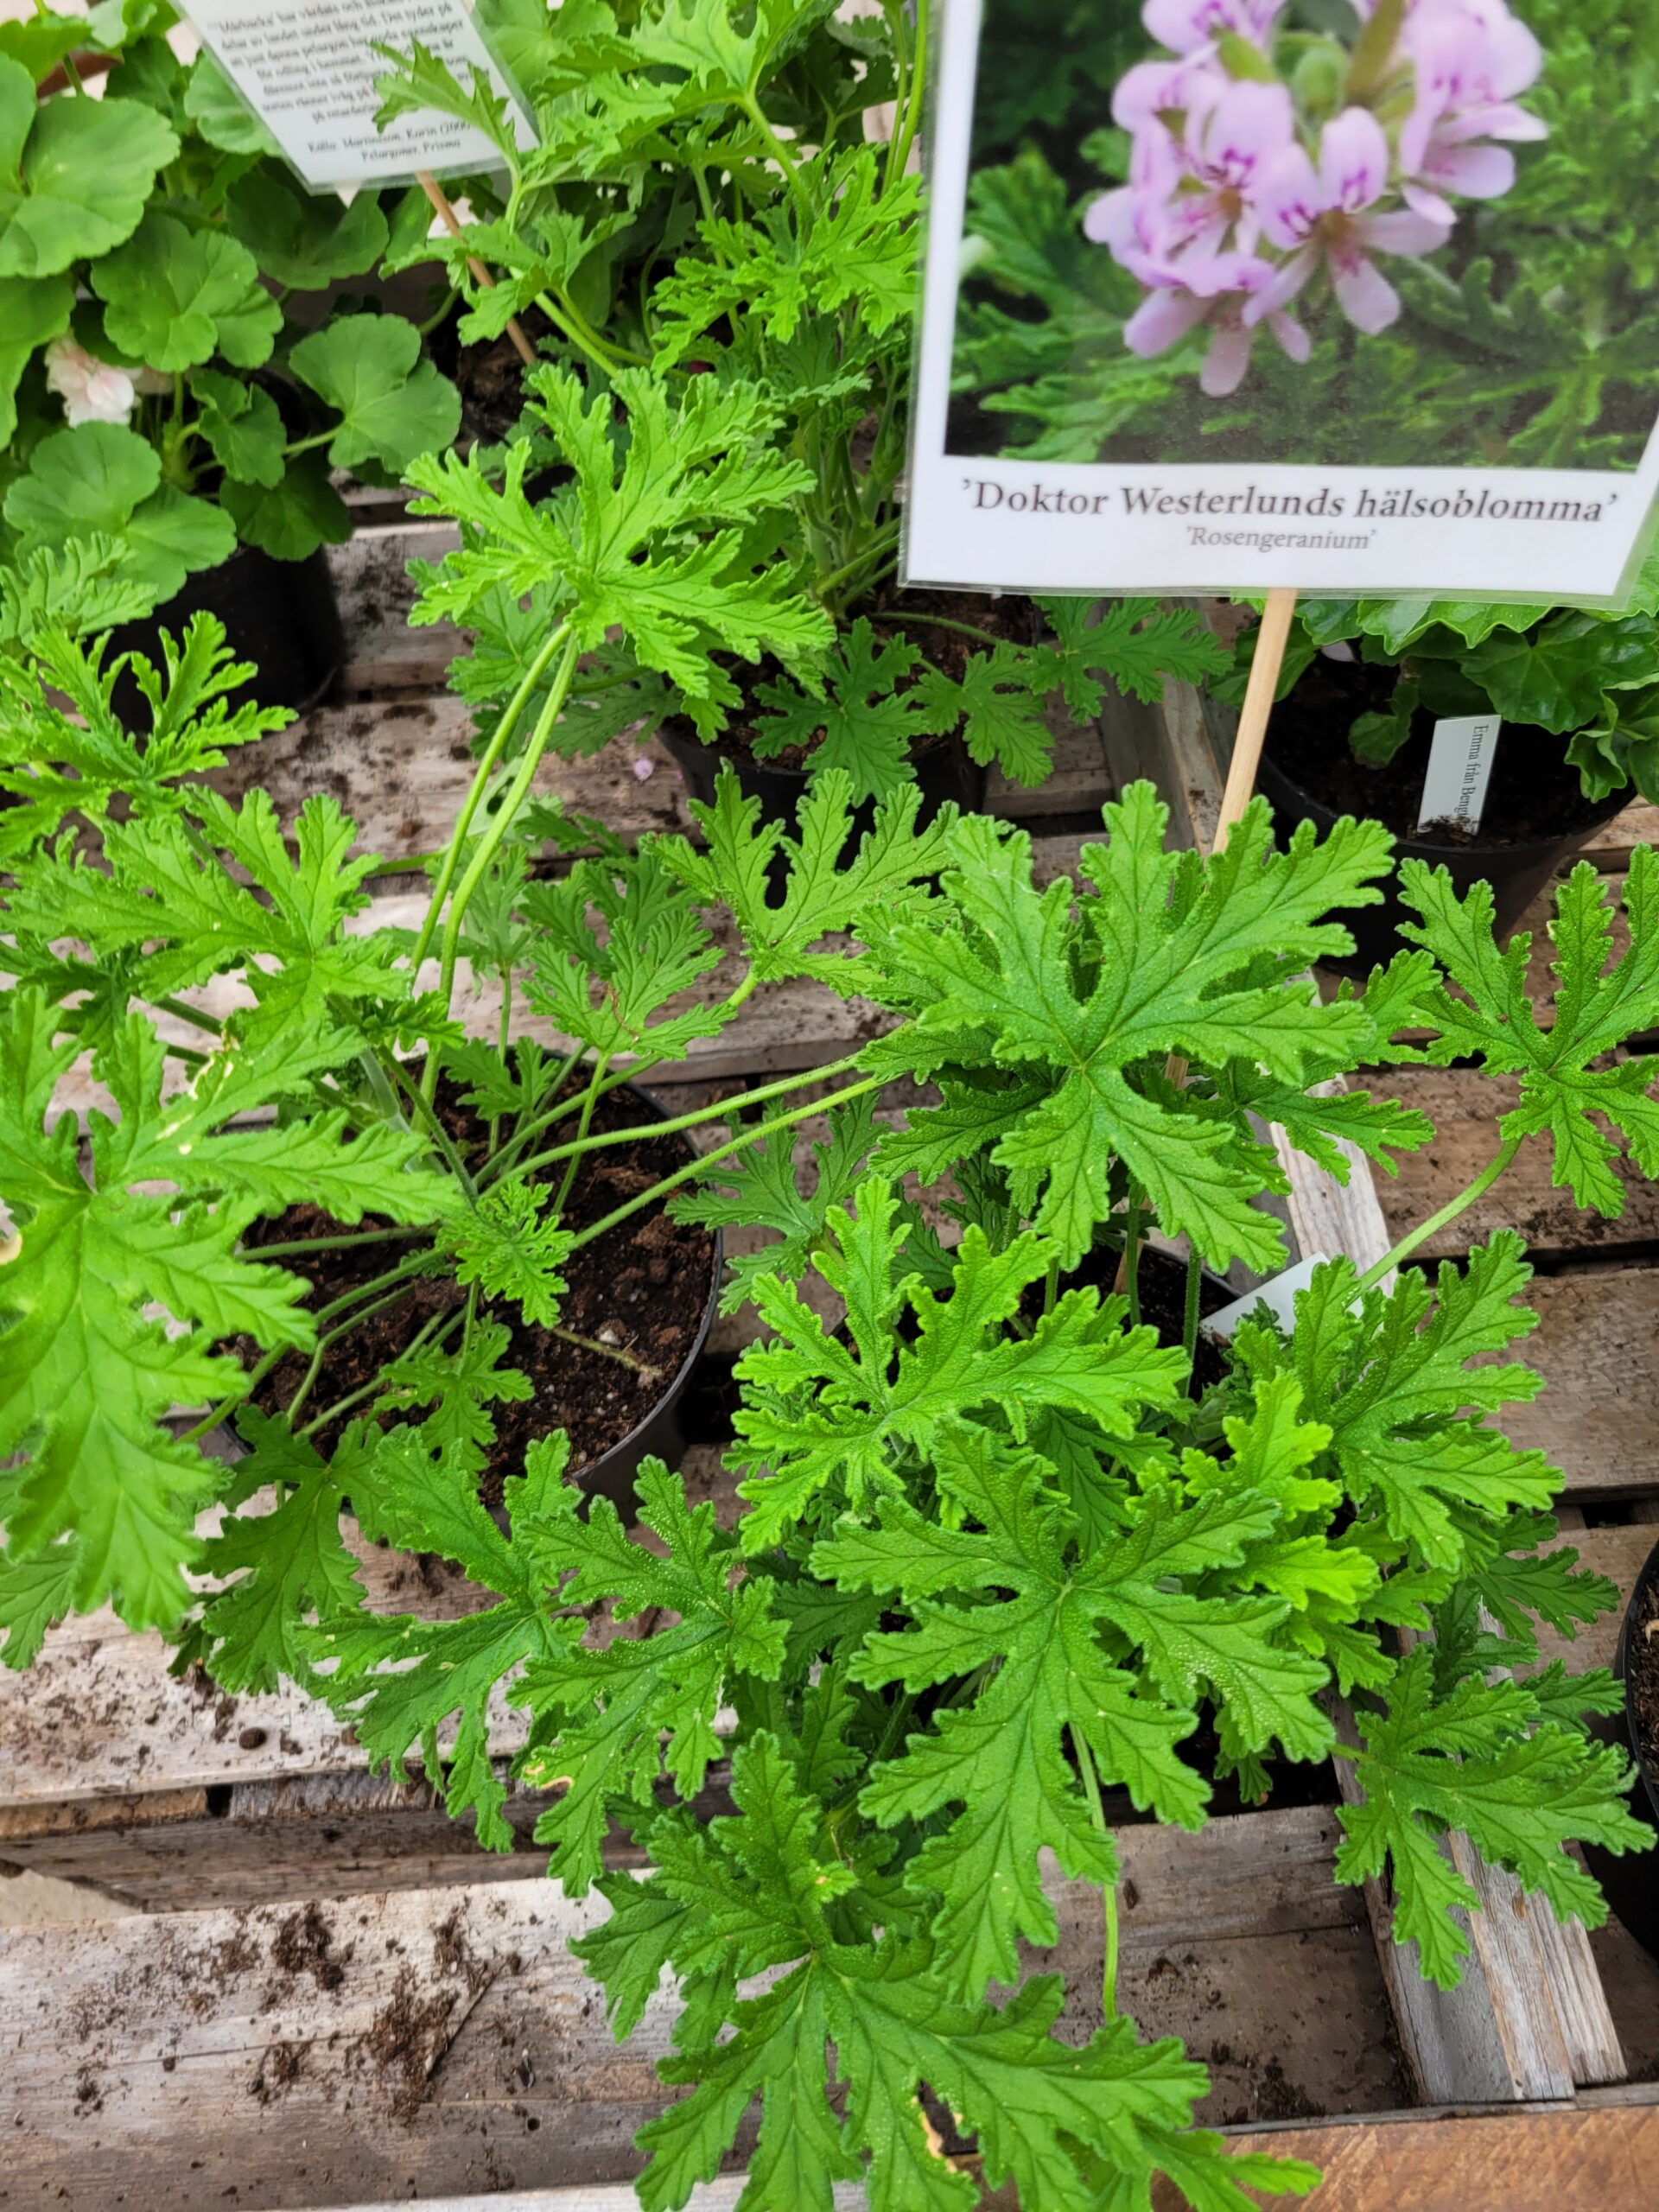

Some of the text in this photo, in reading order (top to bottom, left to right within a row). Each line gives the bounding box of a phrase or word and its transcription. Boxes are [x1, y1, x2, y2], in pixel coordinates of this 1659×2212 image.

[1121, 484, 1345, 520] Westerlunds
[1468, 724, 1490, 760] Emma
[1463, 762, 1482, 785] från
